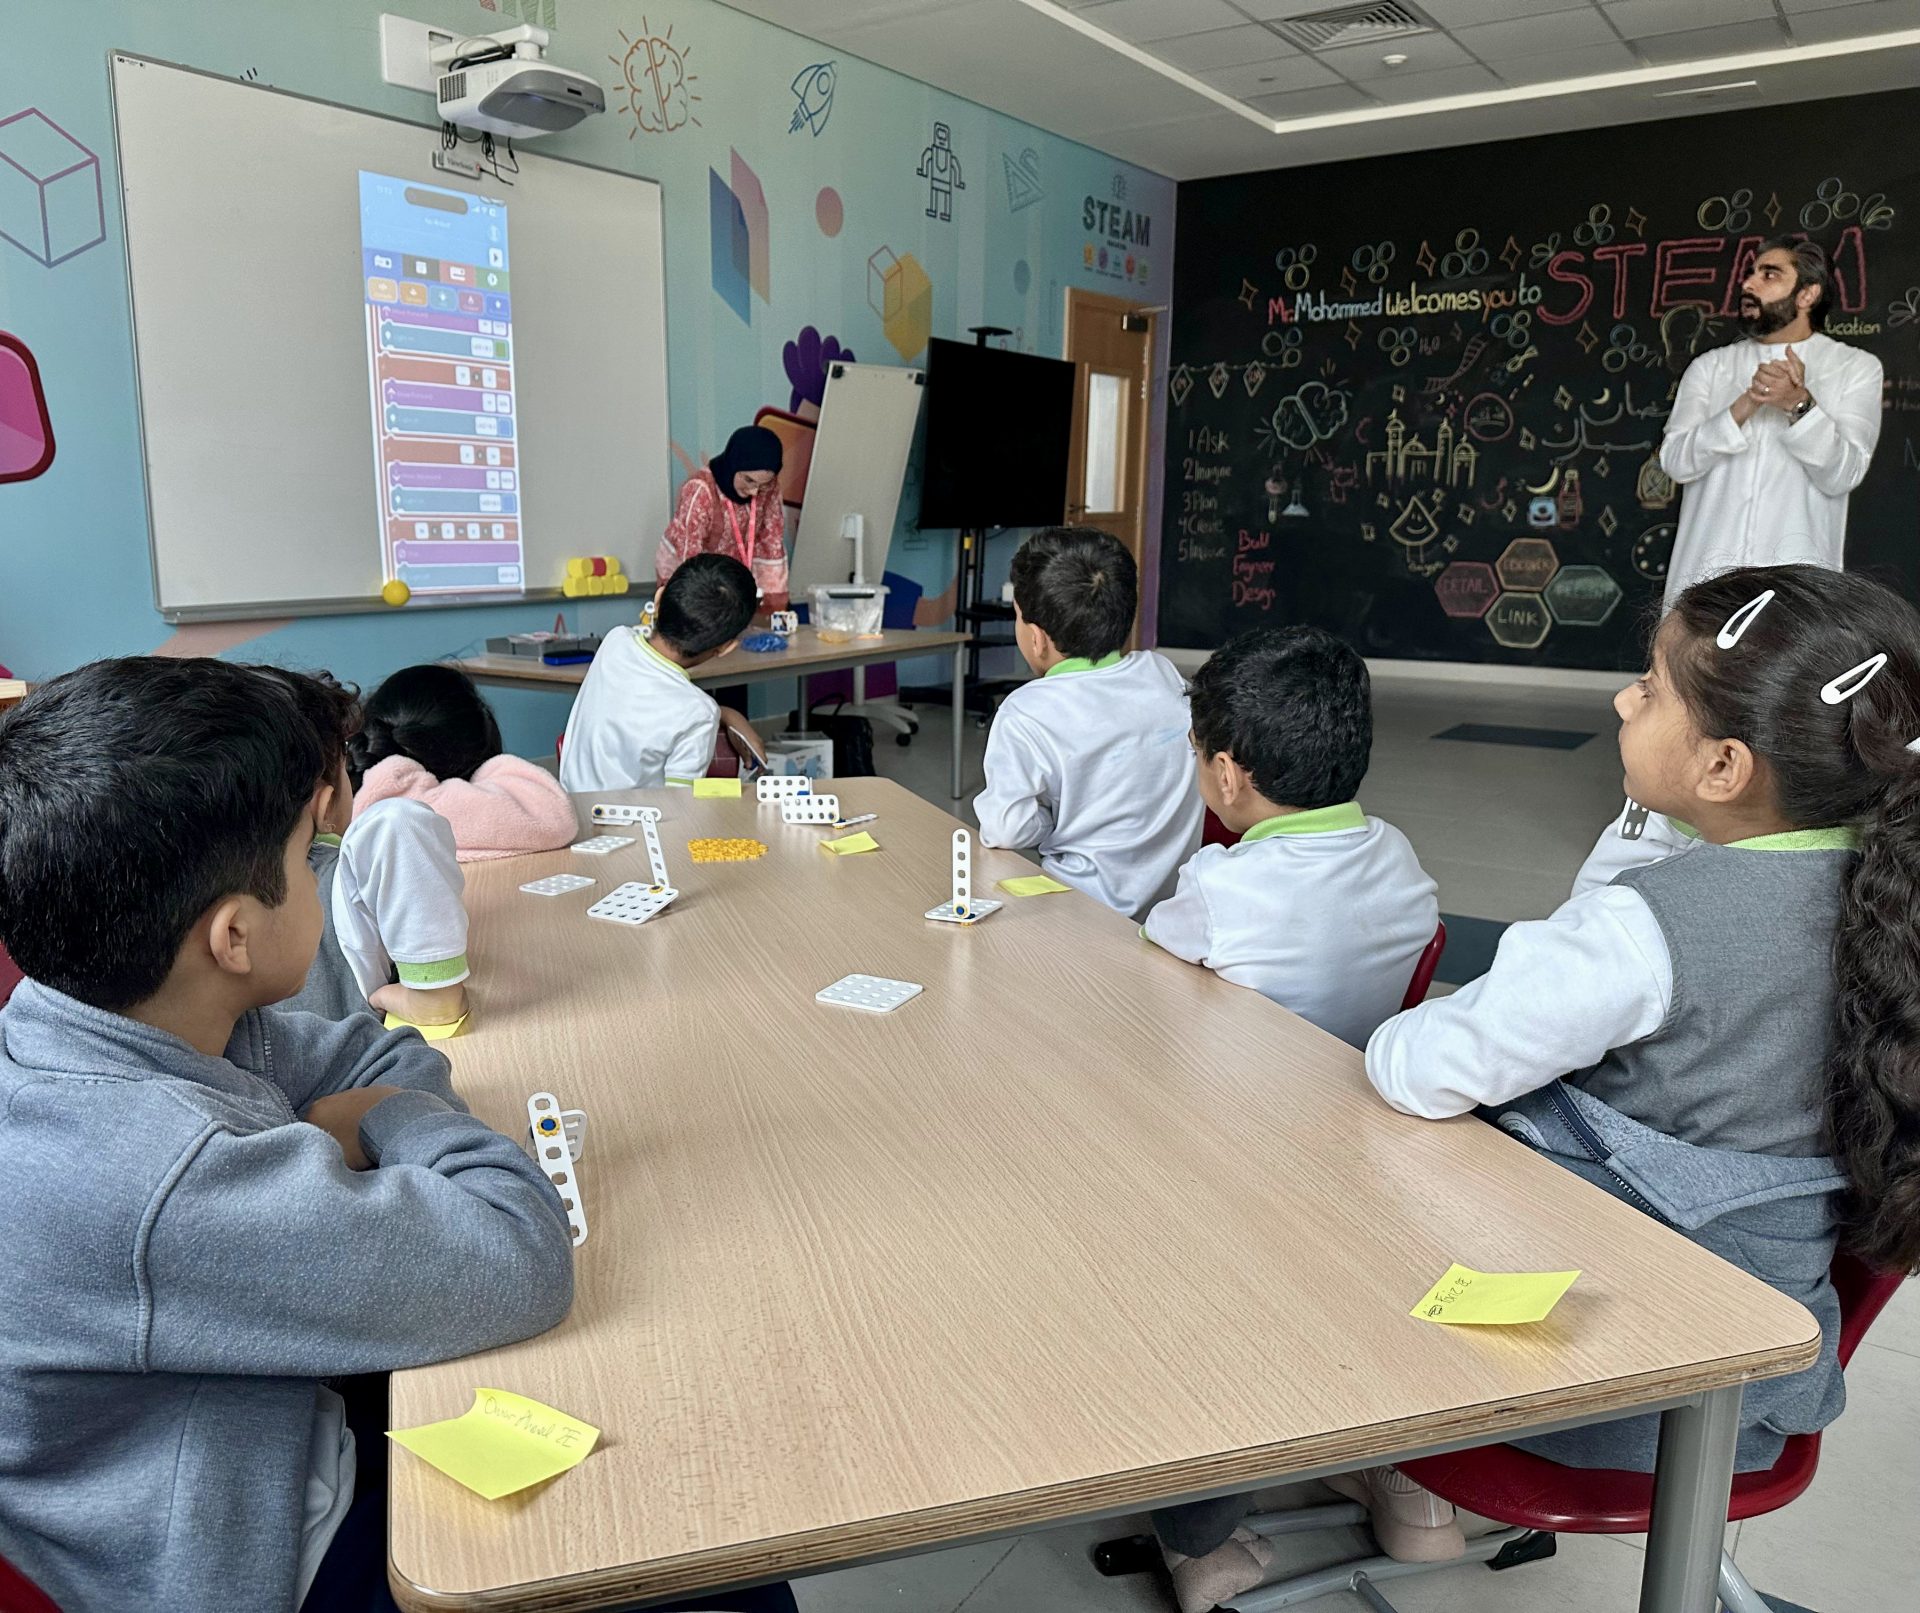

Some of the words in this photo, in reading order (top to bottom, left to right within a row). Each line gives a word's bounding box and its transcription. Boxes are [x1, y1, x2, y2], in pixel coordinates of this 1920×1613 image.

[1083, 195, 1150, 247] STEAM
[1268, 296, 1294, 325] Mr.
[1294, 286, 1384, 322] Mohammed
[1385, 281, 1482, 316] Welcomes
[1481, 288, 1517, 323] you
[1518, 272, 1542, 305] to
[1197, 425, 1229, 454] Ask
[1497, 607, 1538, 627] LINK
